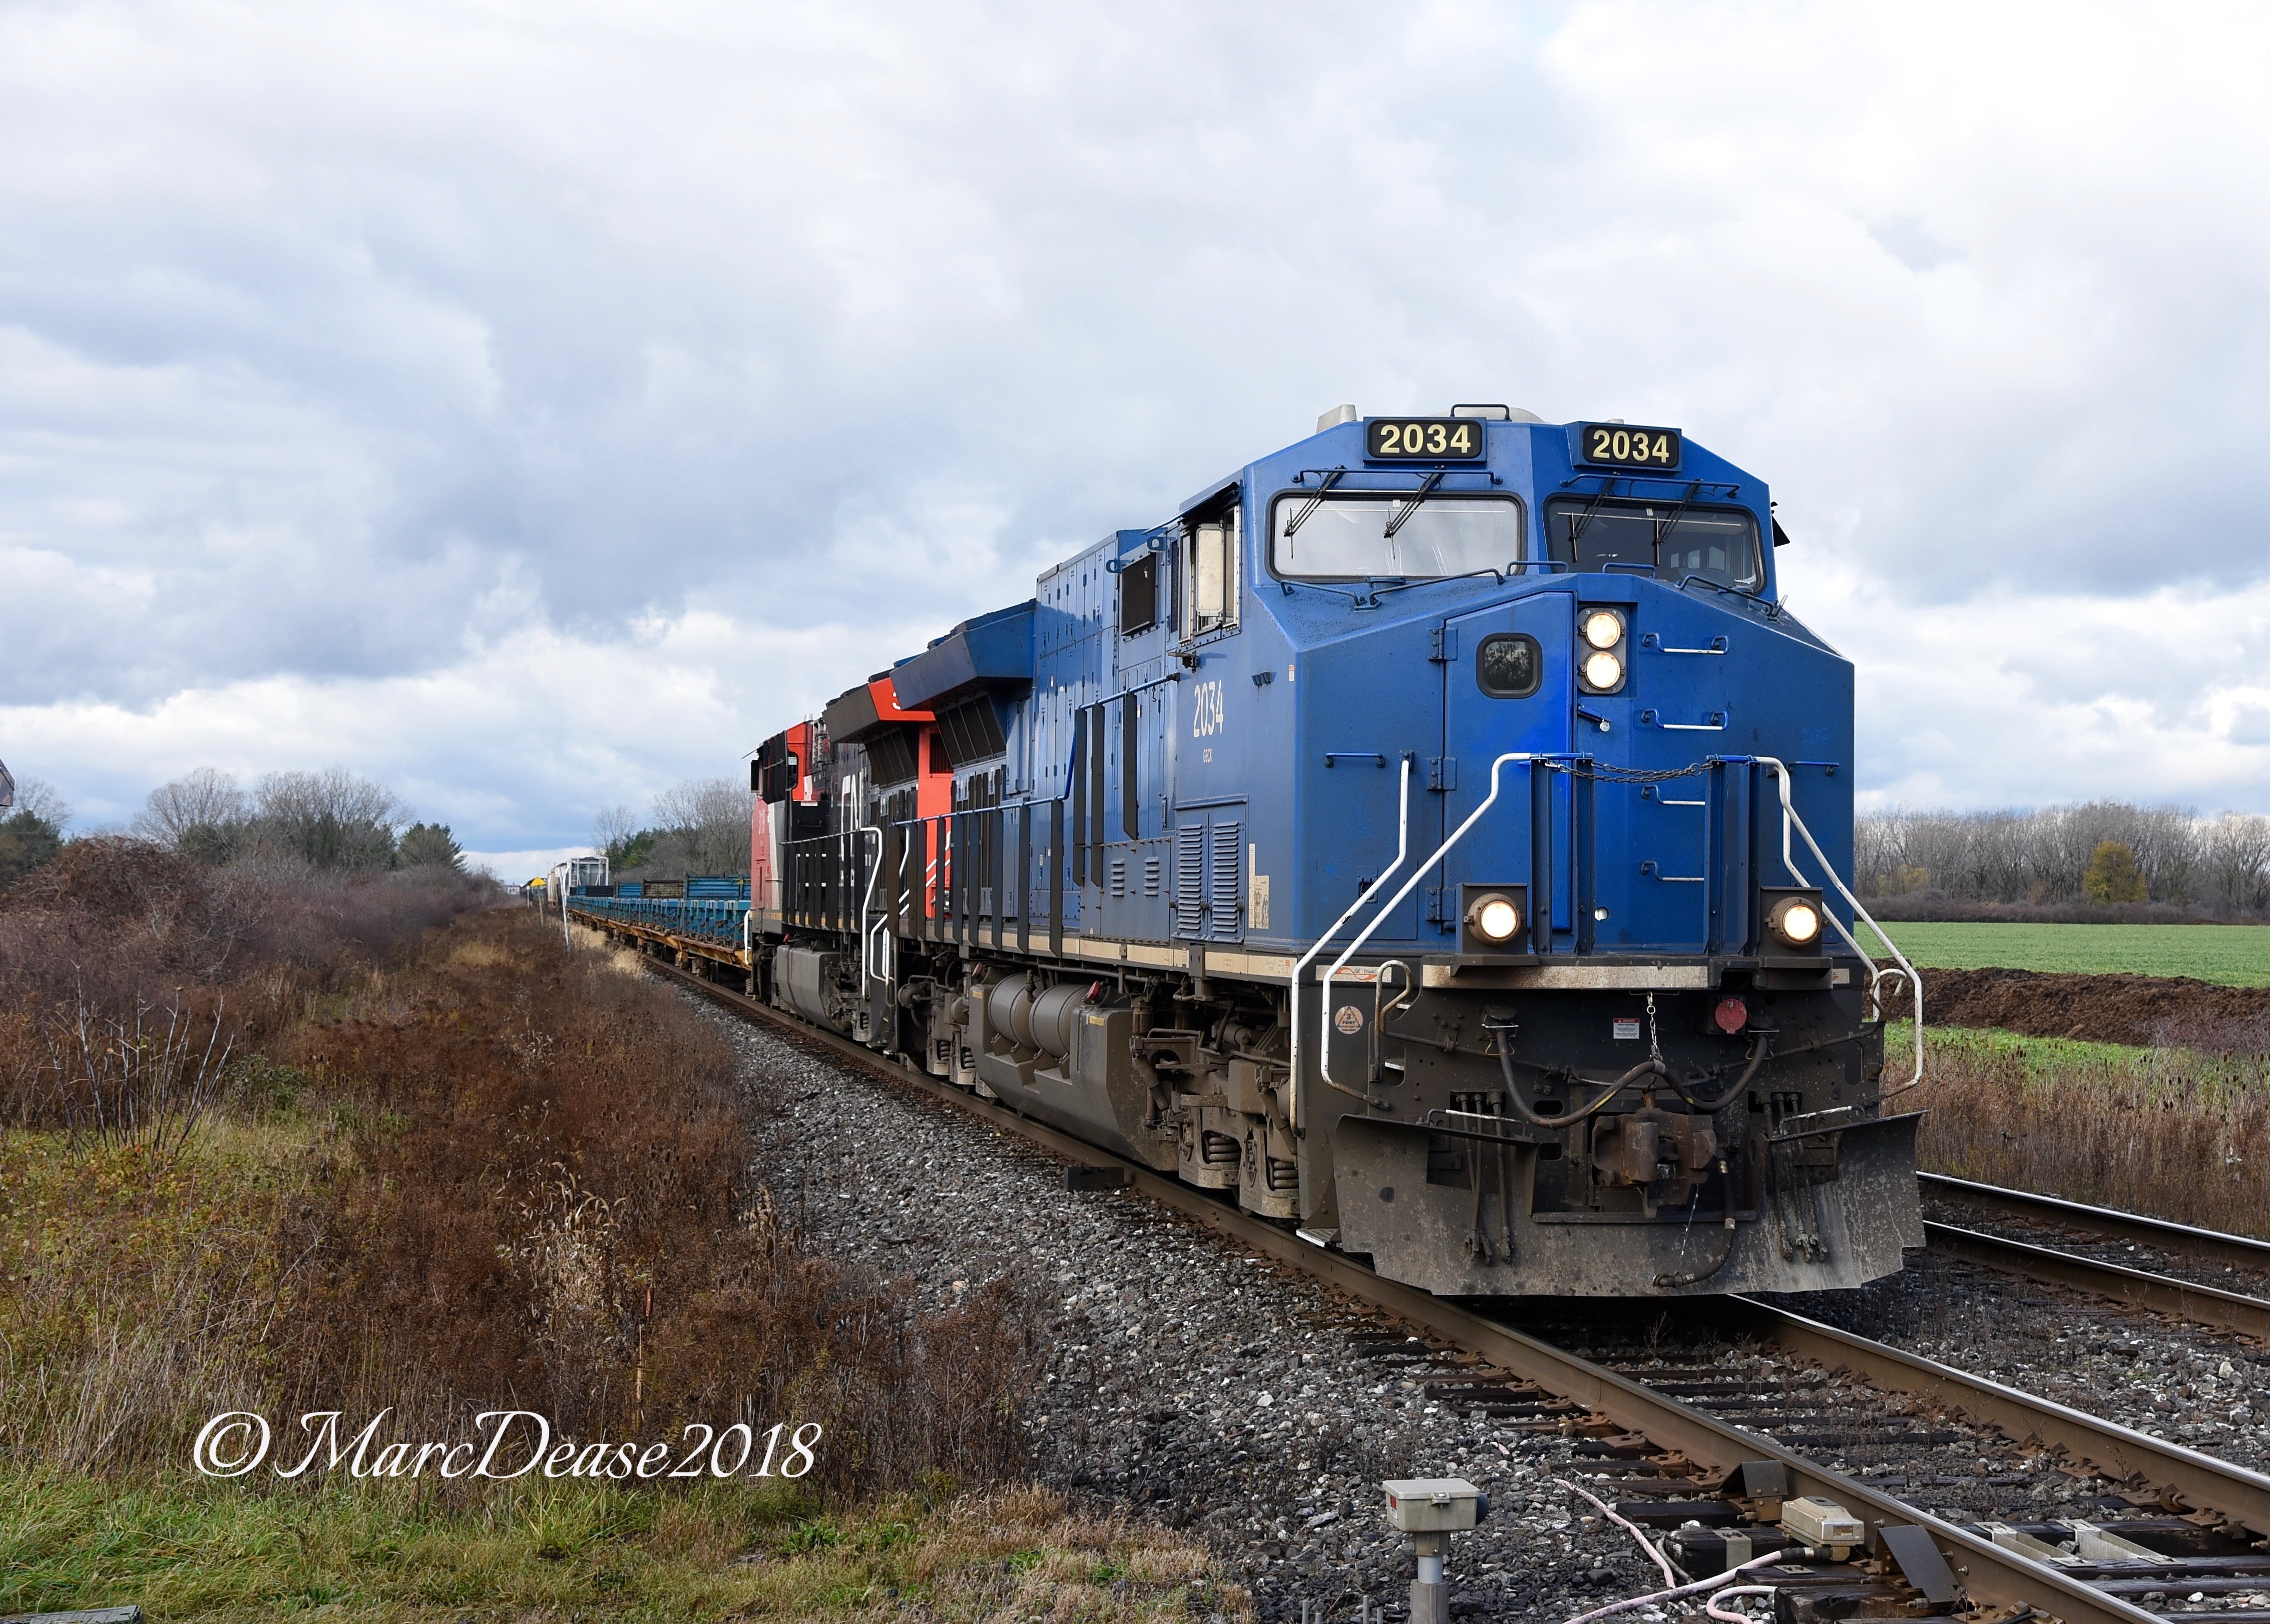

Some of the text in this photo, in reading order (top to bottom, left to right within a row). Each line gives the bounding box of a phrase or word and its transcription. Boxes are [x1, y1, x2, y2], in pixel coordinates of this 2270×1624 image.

[1380, 424, 1471, 453] 2034
[1593, 430, 1669, 463] 2034
[1193, 679, 1223, 738] 2034
